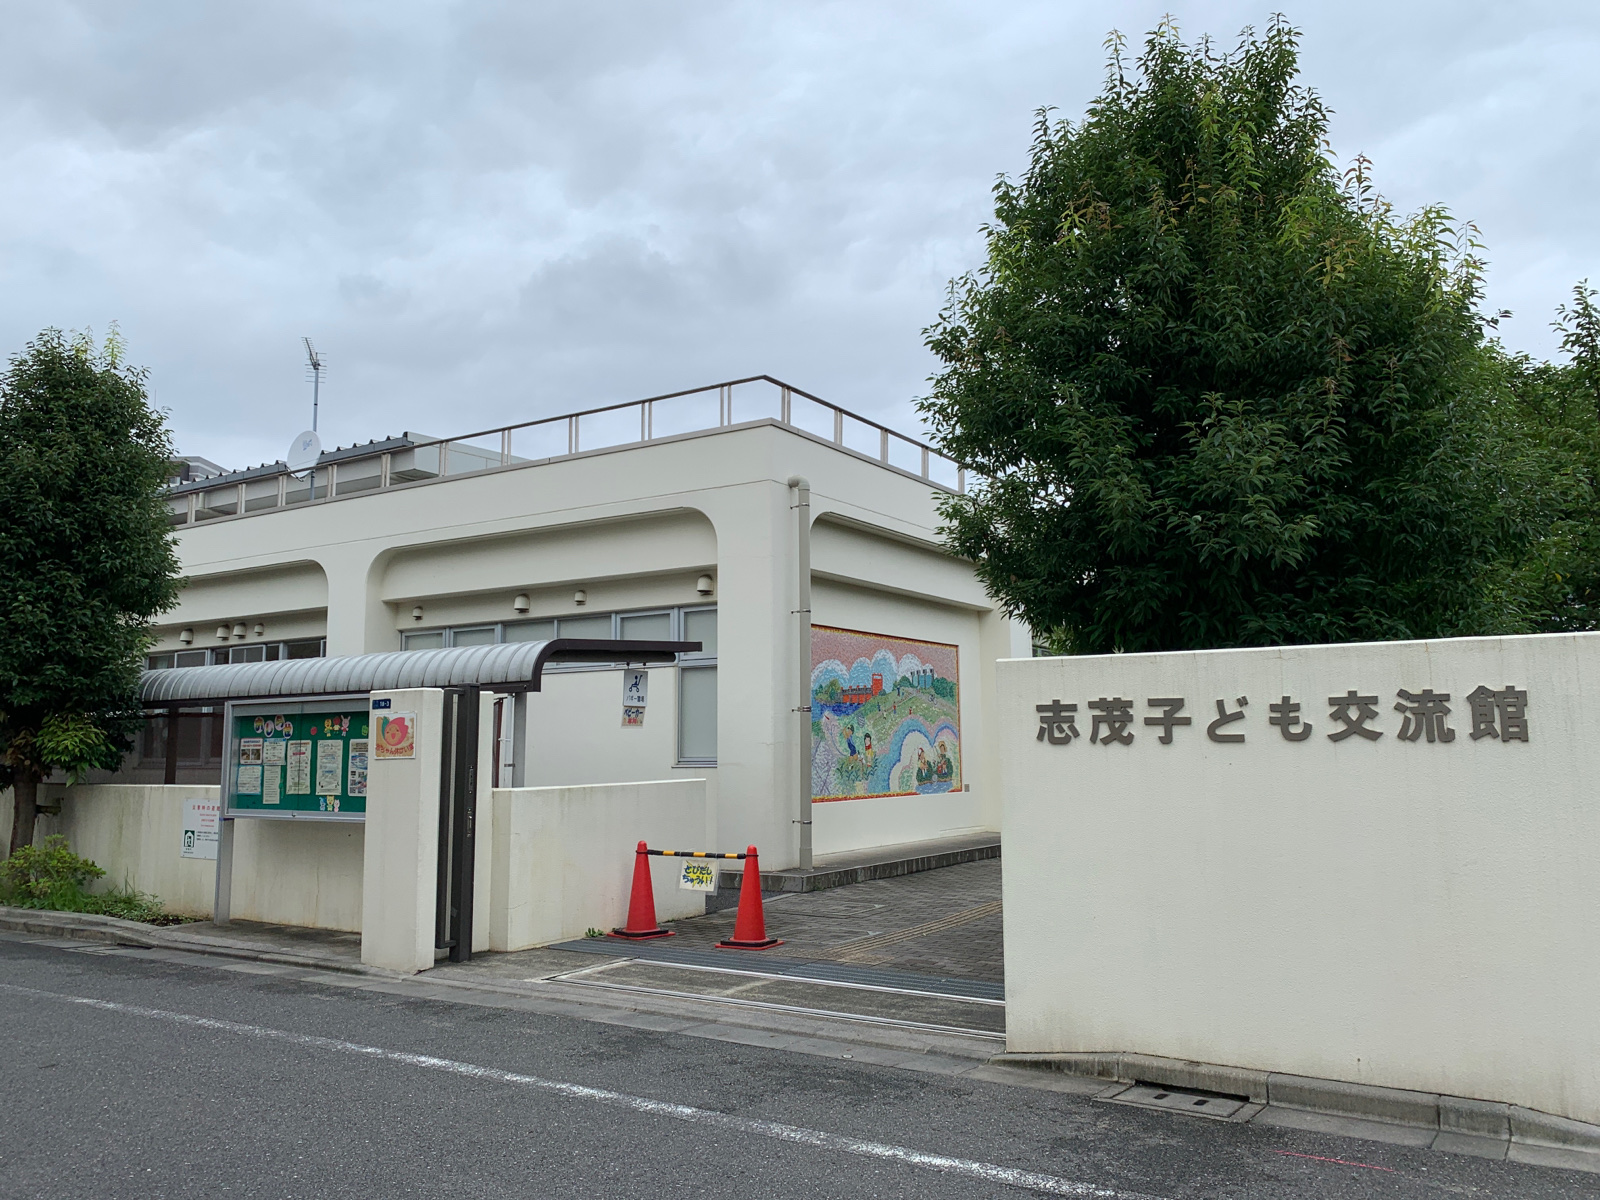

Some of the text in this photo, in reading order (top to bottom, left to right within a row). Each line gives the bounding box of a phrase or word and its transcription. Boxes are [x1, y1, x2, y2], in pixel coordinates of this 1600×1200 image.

[1036, 686, 1528, 745] 志茂子ども交流館
